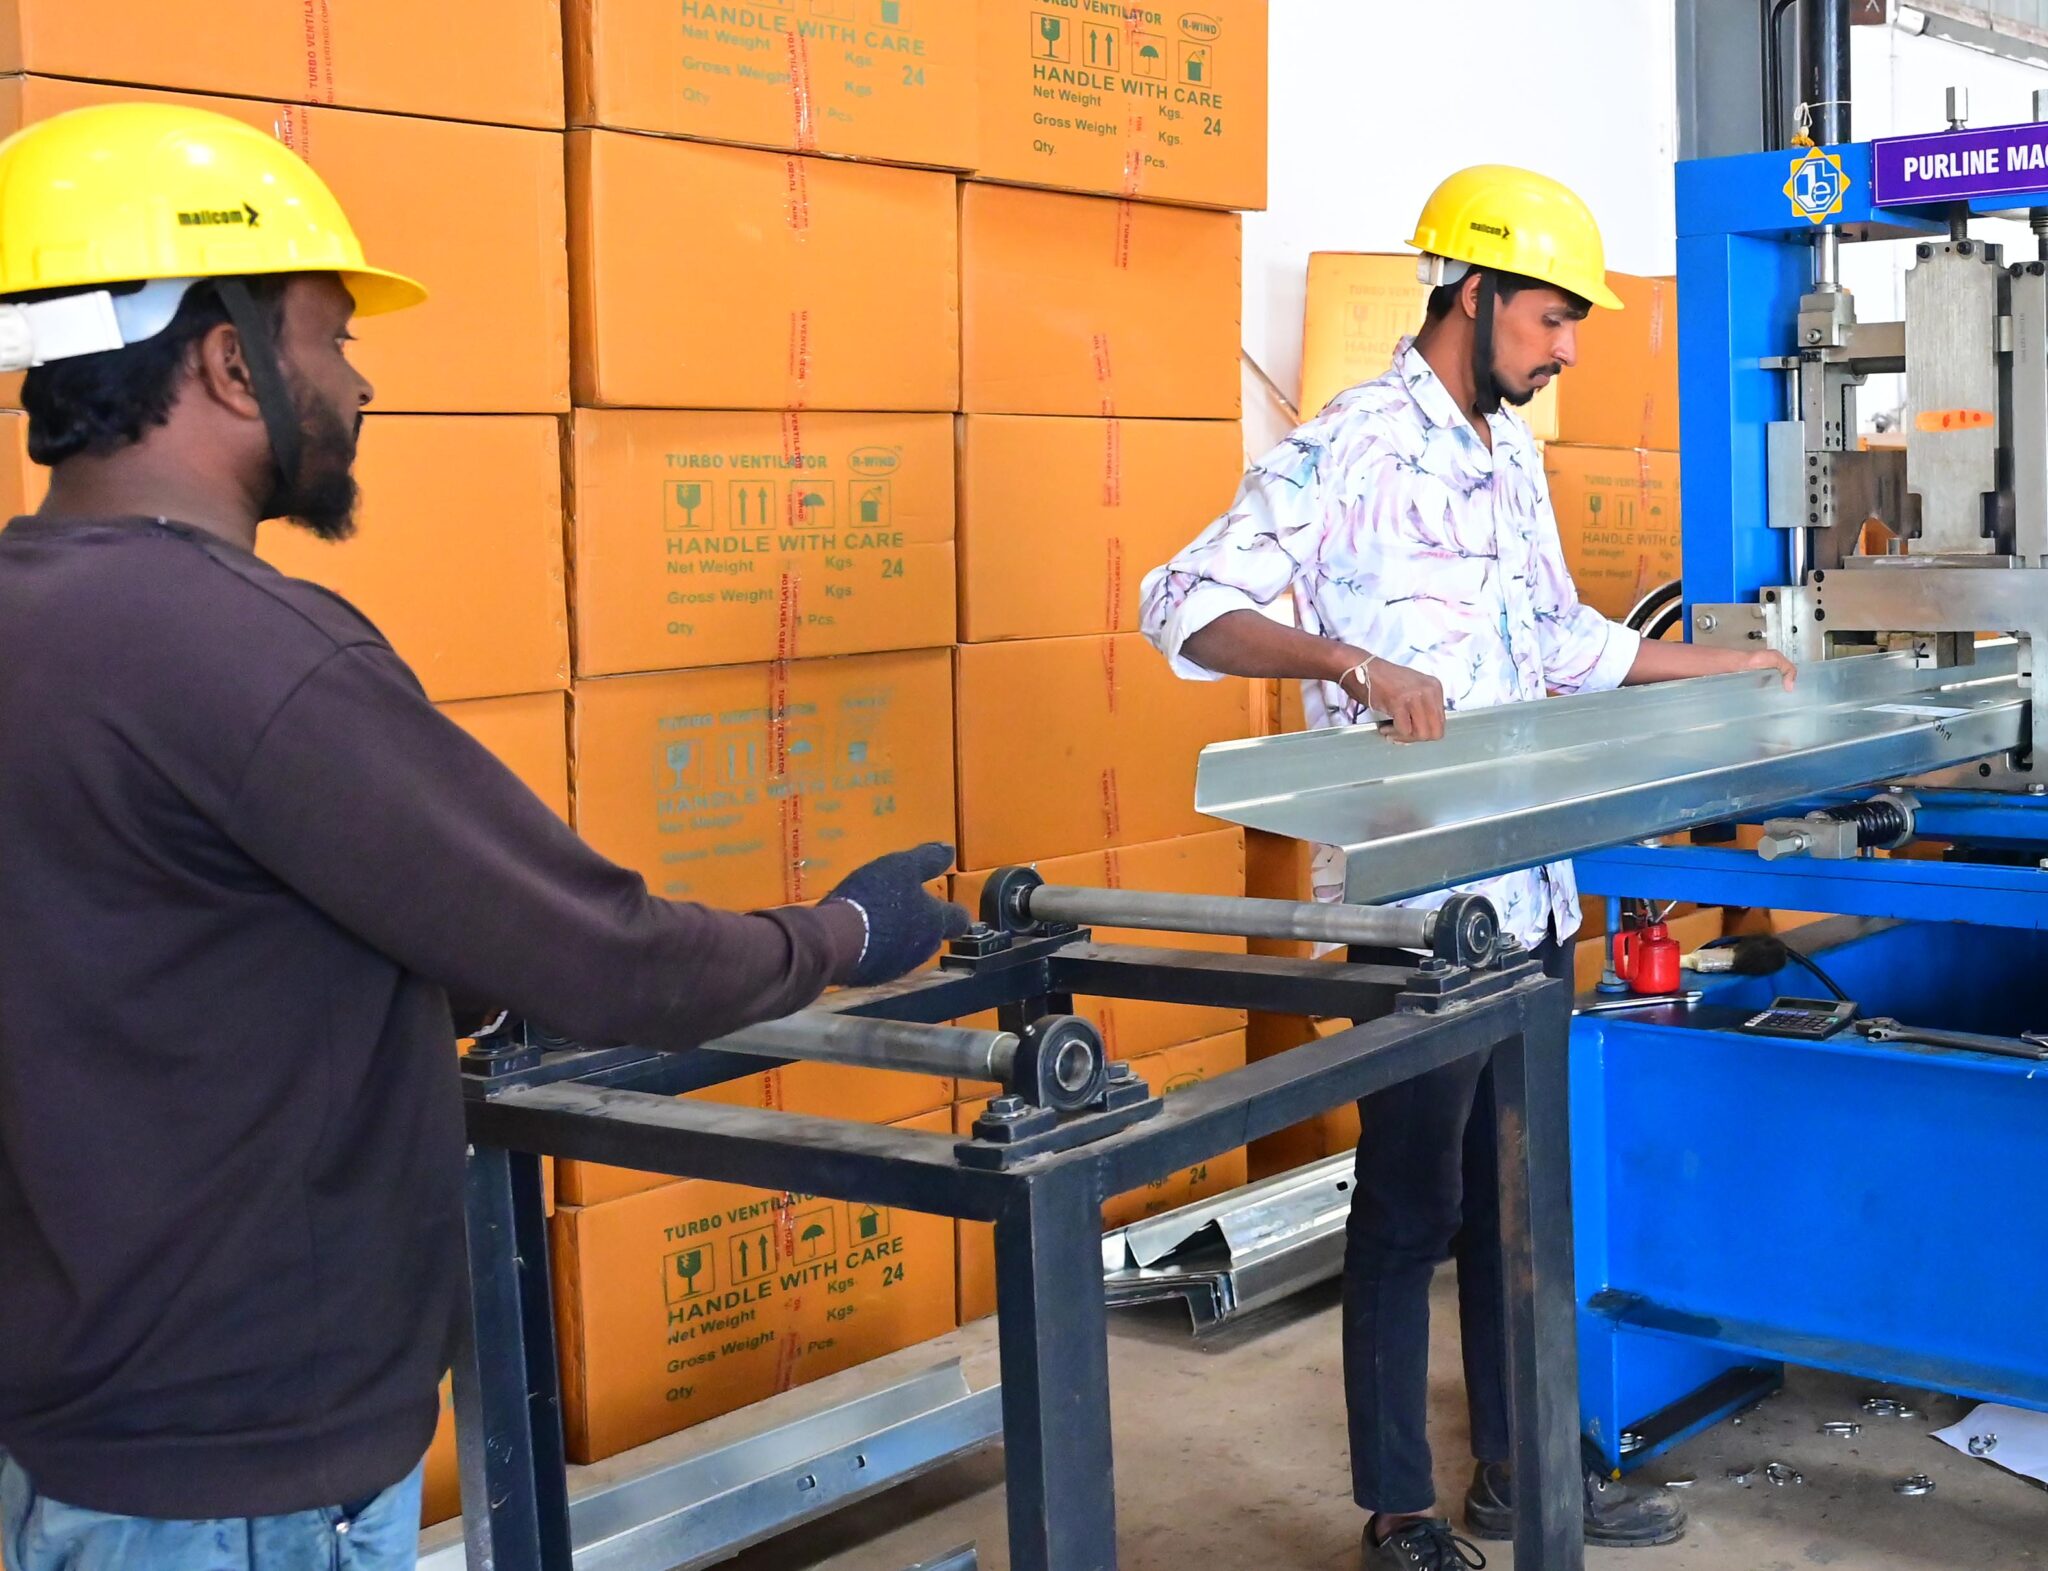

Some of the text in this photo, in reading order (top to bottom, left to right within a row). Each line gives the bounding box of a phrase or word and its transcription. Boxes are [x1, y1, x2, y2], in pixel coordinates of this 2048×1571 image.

[1034, 0, 1162, 25] RBO VENTILATOR
[682, 1, 925, 56] HANDLE WITH CARE
[682, 24, 771, 50] Net Weight
[1182, 18, 1217, 35] R-WIND
[308, 51, 318, 88] TURBO
[682, 56, 732, 76] Gross
[902, 65, 925, 86] 24
[1033, 64, 1223, 109] HANDLE WITH CARE
[1033, 86, 1101, 107] Net Weight
[1033, 113, 1071, 129] Gross
[1075, 119, 1117, 135] Weight
[1203, 117, 1222, 136] 24
[1904, 144, 2048, 182] PURLINE MA
[792, 414, 802, 469] VENTILATOR
[666, 454, 828, 468] TURBO VENTILATOR
[667, 532, 904, 554] HANDLE WITH CARE
[1582, 532, 1634, 545] HANDLE
[1638, 534, 1667, 545] WITH
[667, 559, 754, 576] Net Weight
[882, 558, 904, 578] 24
[667, 590, 773, 605] Gross Weight
[780, 574, 788, 628] VENTILATOR
[1190, 1164, 1207, 1185] 24
[664, 1215, 722, 1242] TURBO
[669, 1237, 904, 1324] HANDLE WITH CARE
[883, 1262, 904, 1287] 24
[700, 1309, 756, 1334] Weight
[667, 1330, 775, 1373] Gross Weight
